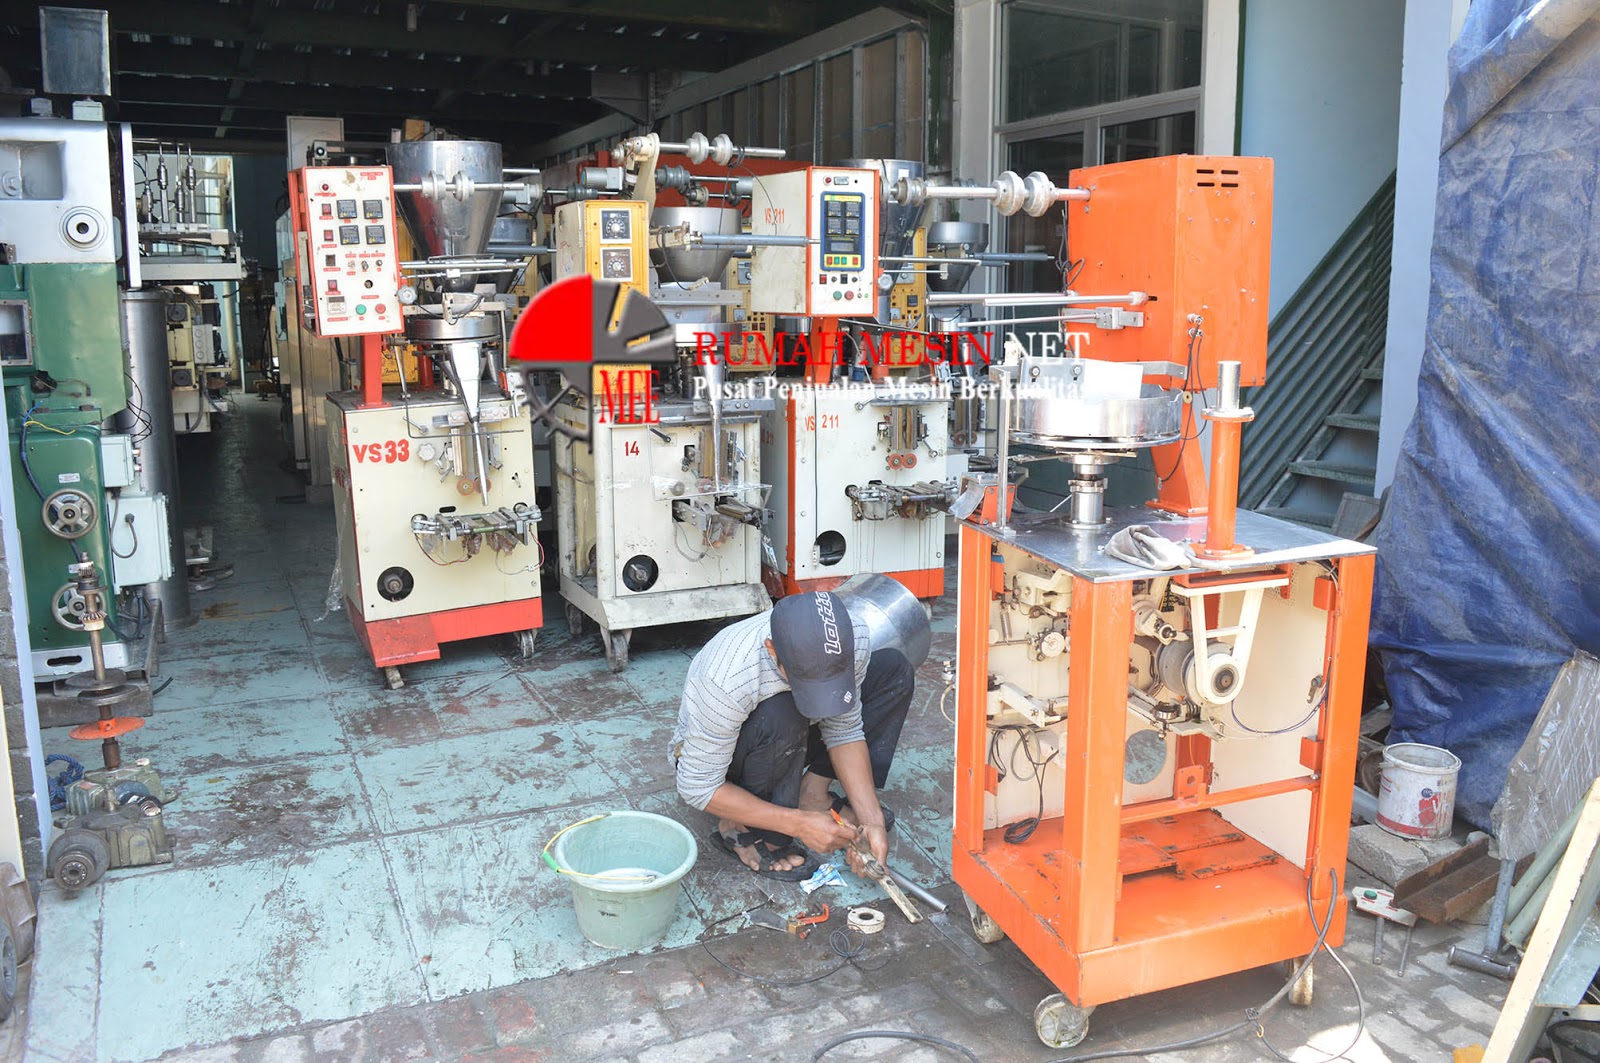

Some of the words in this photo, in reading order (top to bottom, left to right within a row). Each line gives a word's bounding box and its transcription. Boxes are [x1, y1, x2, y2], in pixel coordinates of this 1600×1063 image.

[765, 208, 772, 224] VS
[775, 208, 785, 224] 211
[805, 416, 815, 432] VS
[822, 414, 839, 429] 211
[624, 440, 640, 457] 14
